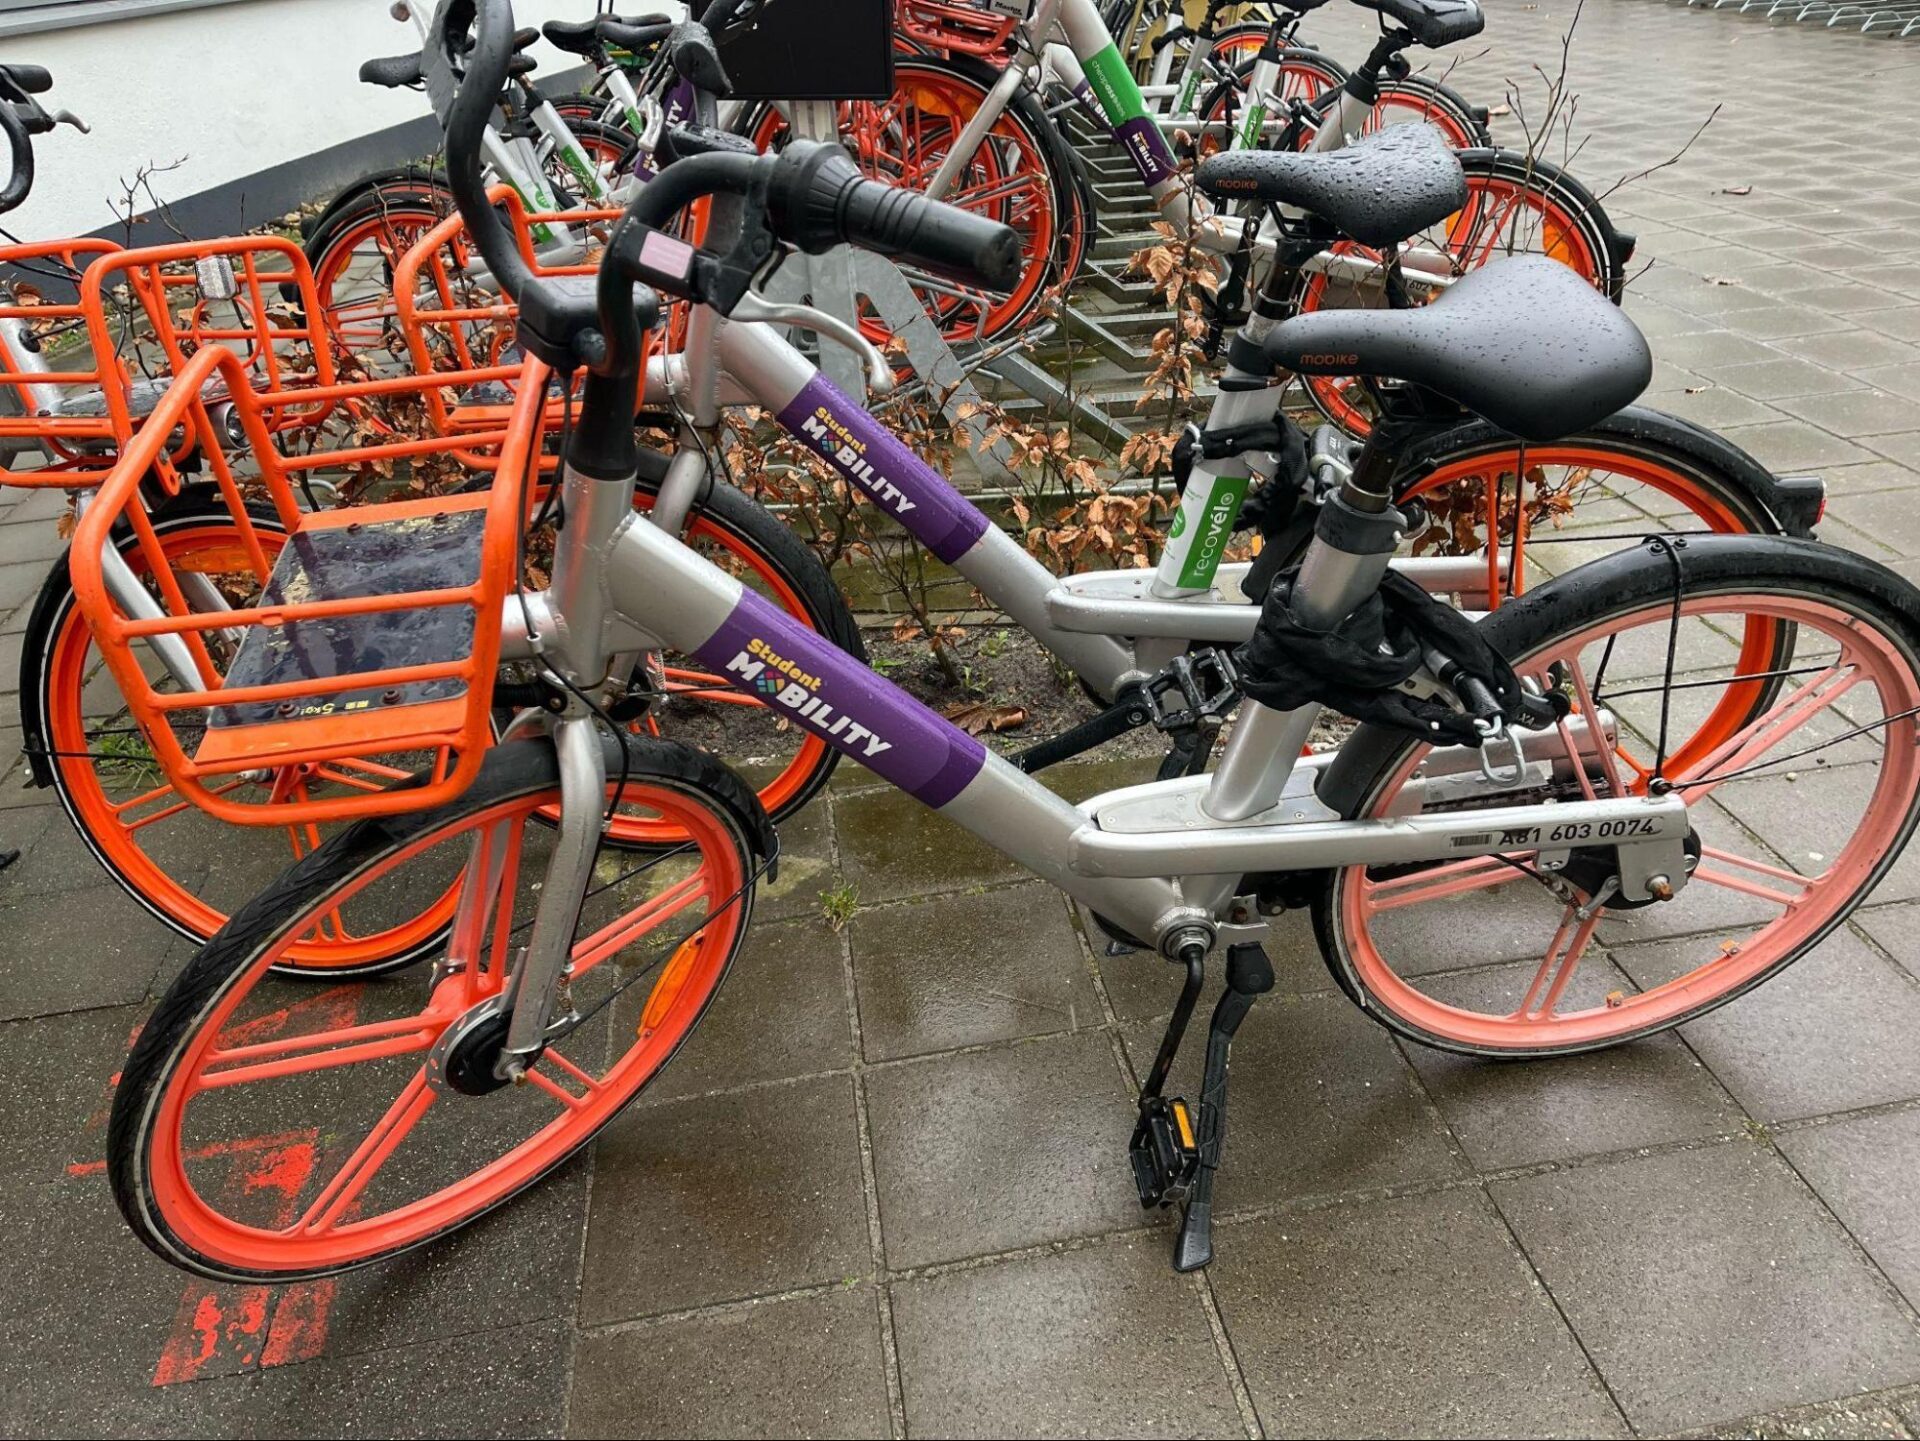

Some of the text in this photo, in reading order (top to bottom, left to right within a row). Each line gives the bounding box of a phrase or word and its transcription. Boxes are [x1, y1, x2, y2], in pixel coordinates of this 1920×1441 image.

[1215, 179, 1258, 190] mobike
[1300, 353, 1359, 365] mobike
[814, 406, 867, 454] Student
[801, 415, 917, 514] MOBILITY
[1193, 492, 1235, 577] recovélo
[747, 638, 822, 692] Student
[725, 651, 893, 757] MOBILITY
[1500, 818, 1654, 846] A81 603 0074
